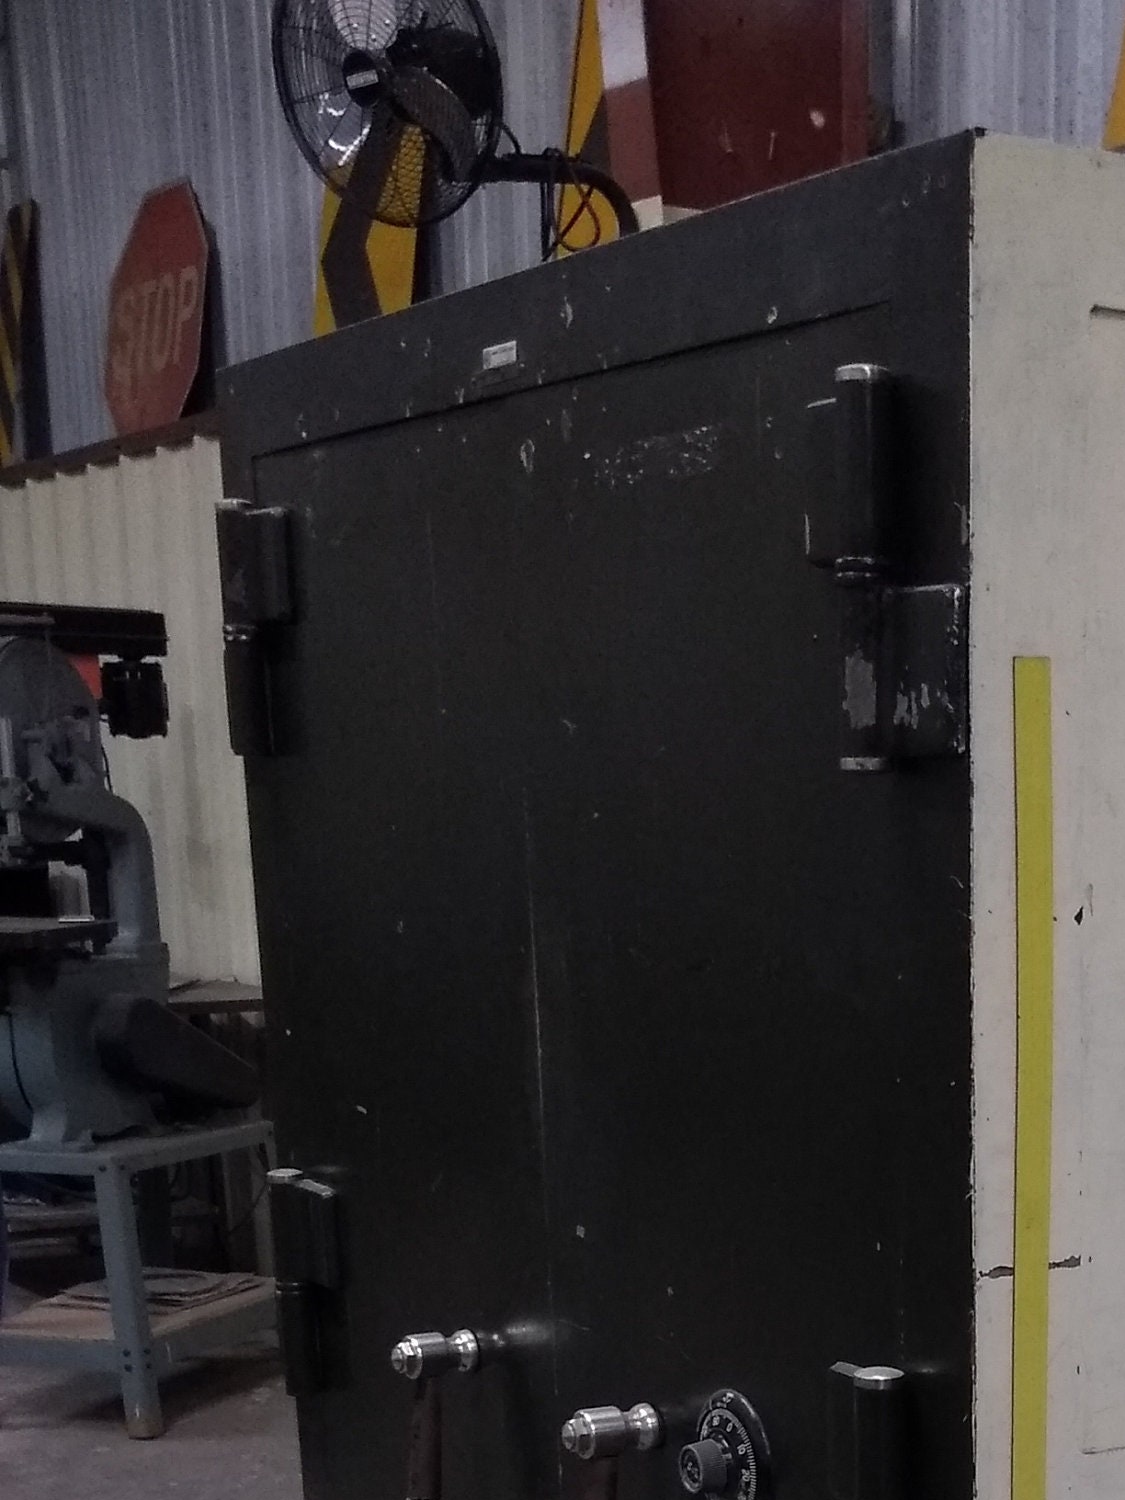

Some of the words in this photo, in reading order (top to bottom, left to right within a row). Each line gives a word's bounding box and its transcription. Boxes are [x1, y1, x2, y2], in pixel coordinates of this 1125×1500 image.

[112, 266, 198, 392] STOP
[726, 1422, 733, 1433] 0
[736, 1443, 746, 1455] 10
[741, 1468, 750, 1482] 20
